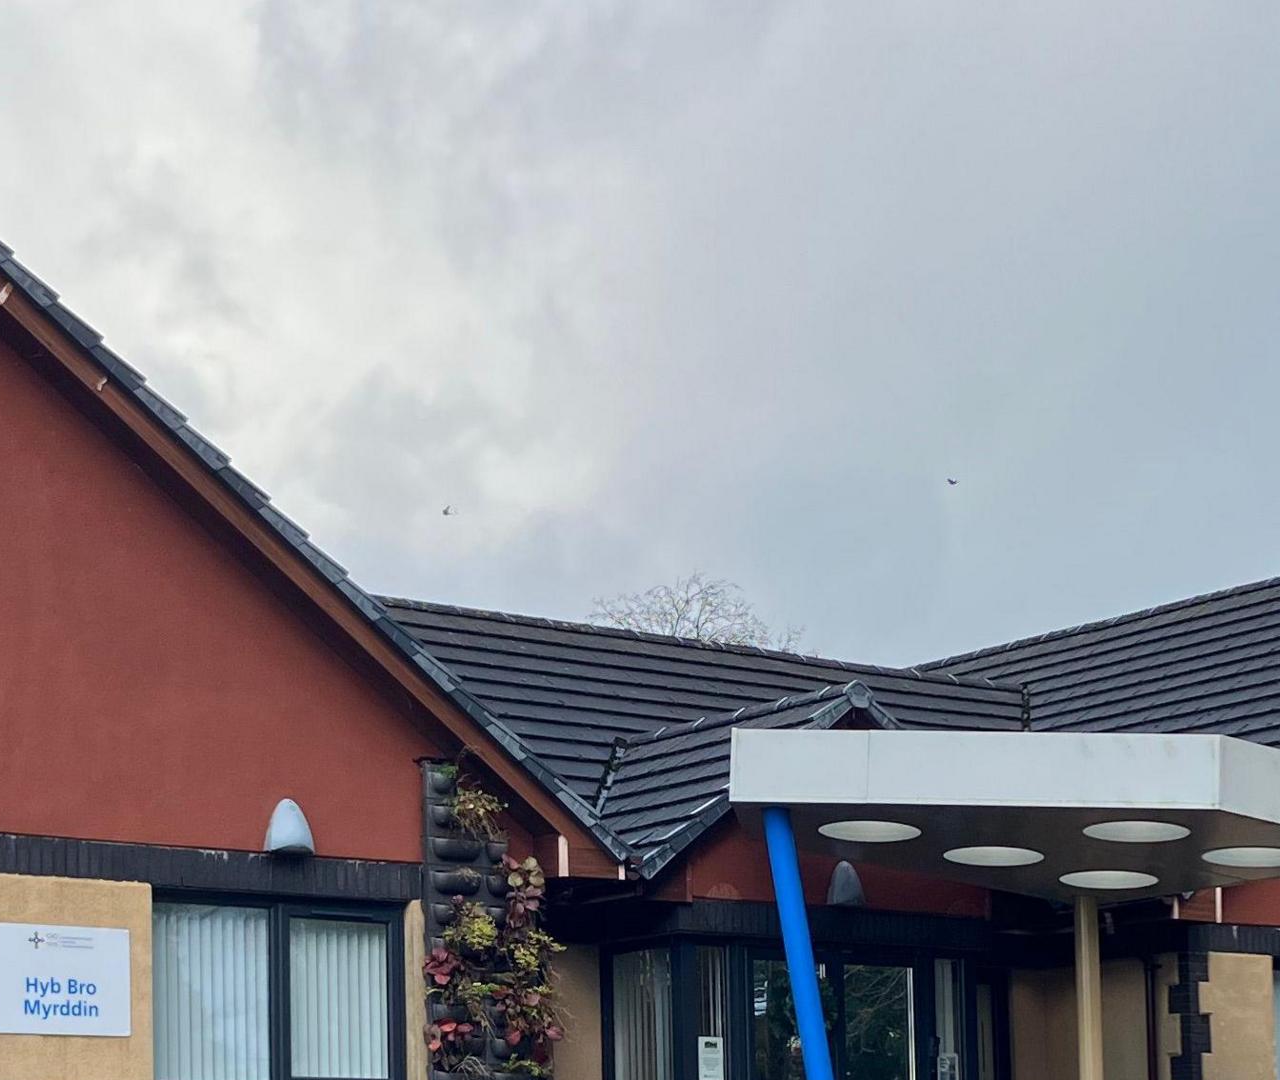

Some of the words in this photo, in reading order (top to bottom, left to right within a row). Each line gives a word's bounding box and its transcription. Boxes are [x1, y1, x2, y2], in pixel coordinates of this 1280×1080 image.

[25, 976, 61, 998] Hyb
[67, 978, 97, 996] Bro
[23, 999, 99, 1020] Myrddin
